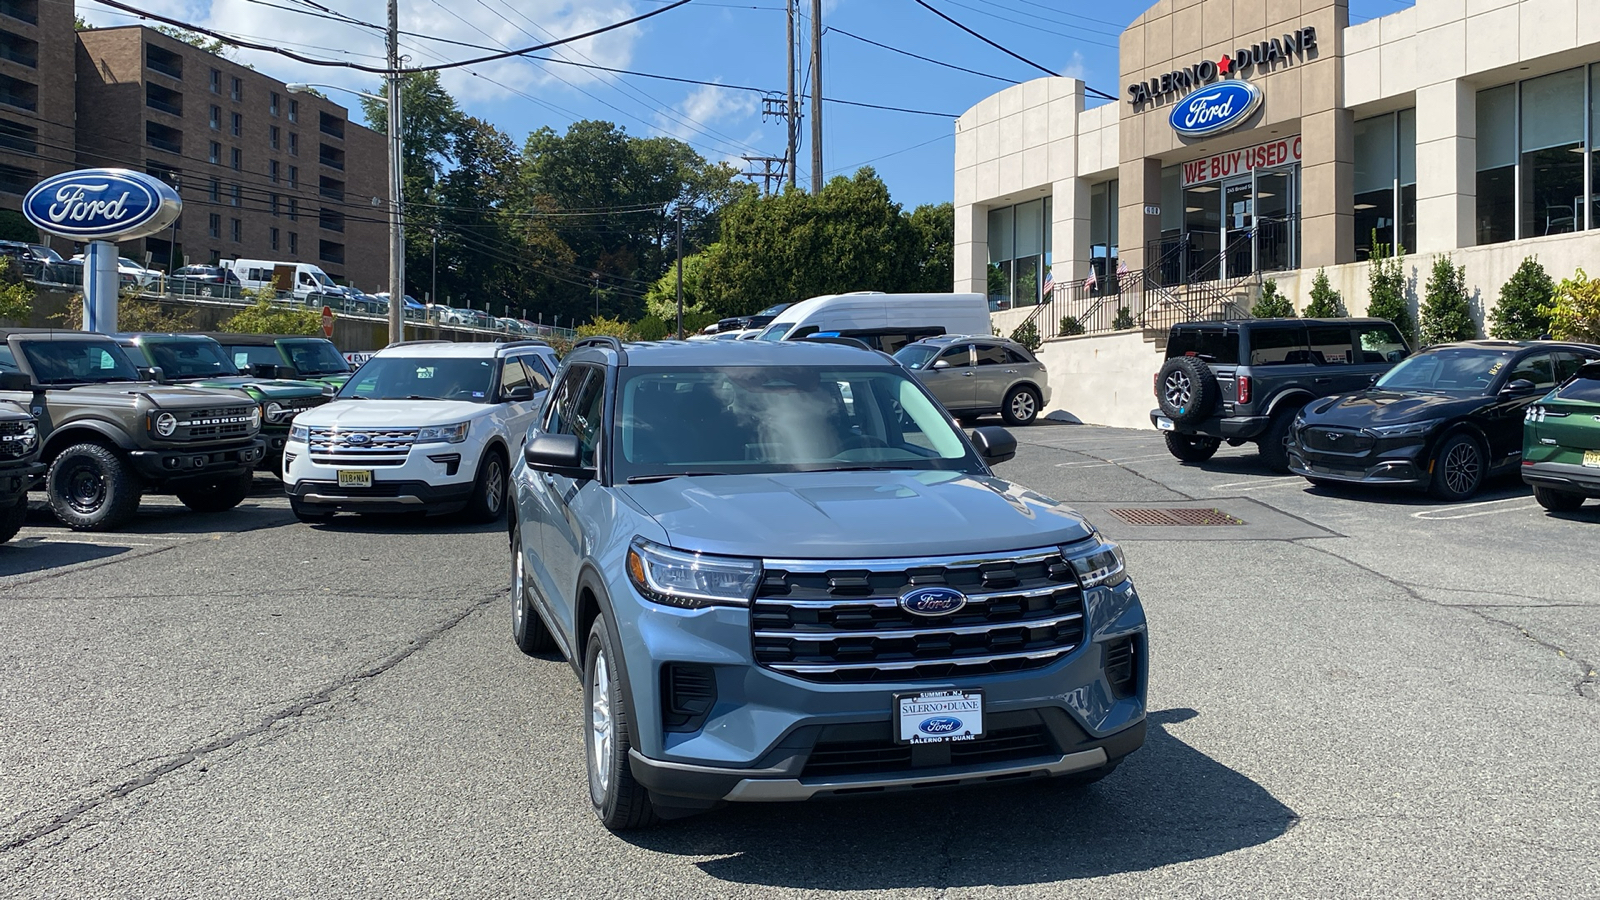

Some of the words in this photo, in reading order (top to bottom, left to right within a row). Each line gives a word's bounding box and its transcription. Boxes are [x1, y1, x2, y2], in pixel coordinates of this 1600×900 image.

[1127, 60, 1218, 104] SALERNO
[1235, 26, 1317, 71] DUANE
[1185, 92, 1234, 128] Ford
[1184, 160, 1207, 184] WE
[1211, 151, 1241, 178] BUY
[1245, 141, 1288, 170] USED
[48, 184, 130, 222] Ford
[192, 416, 246, 425] BRONCO
[917, 594, 952, 610] Ford
[902, 702, 943, 714] SALERNO
[947, 700, 979, 711] DUANE
[927, 719, 954, 732] Ford
[910, 736, 942, 745] SALERNO
[952, 734, 975, 742] DUANE
